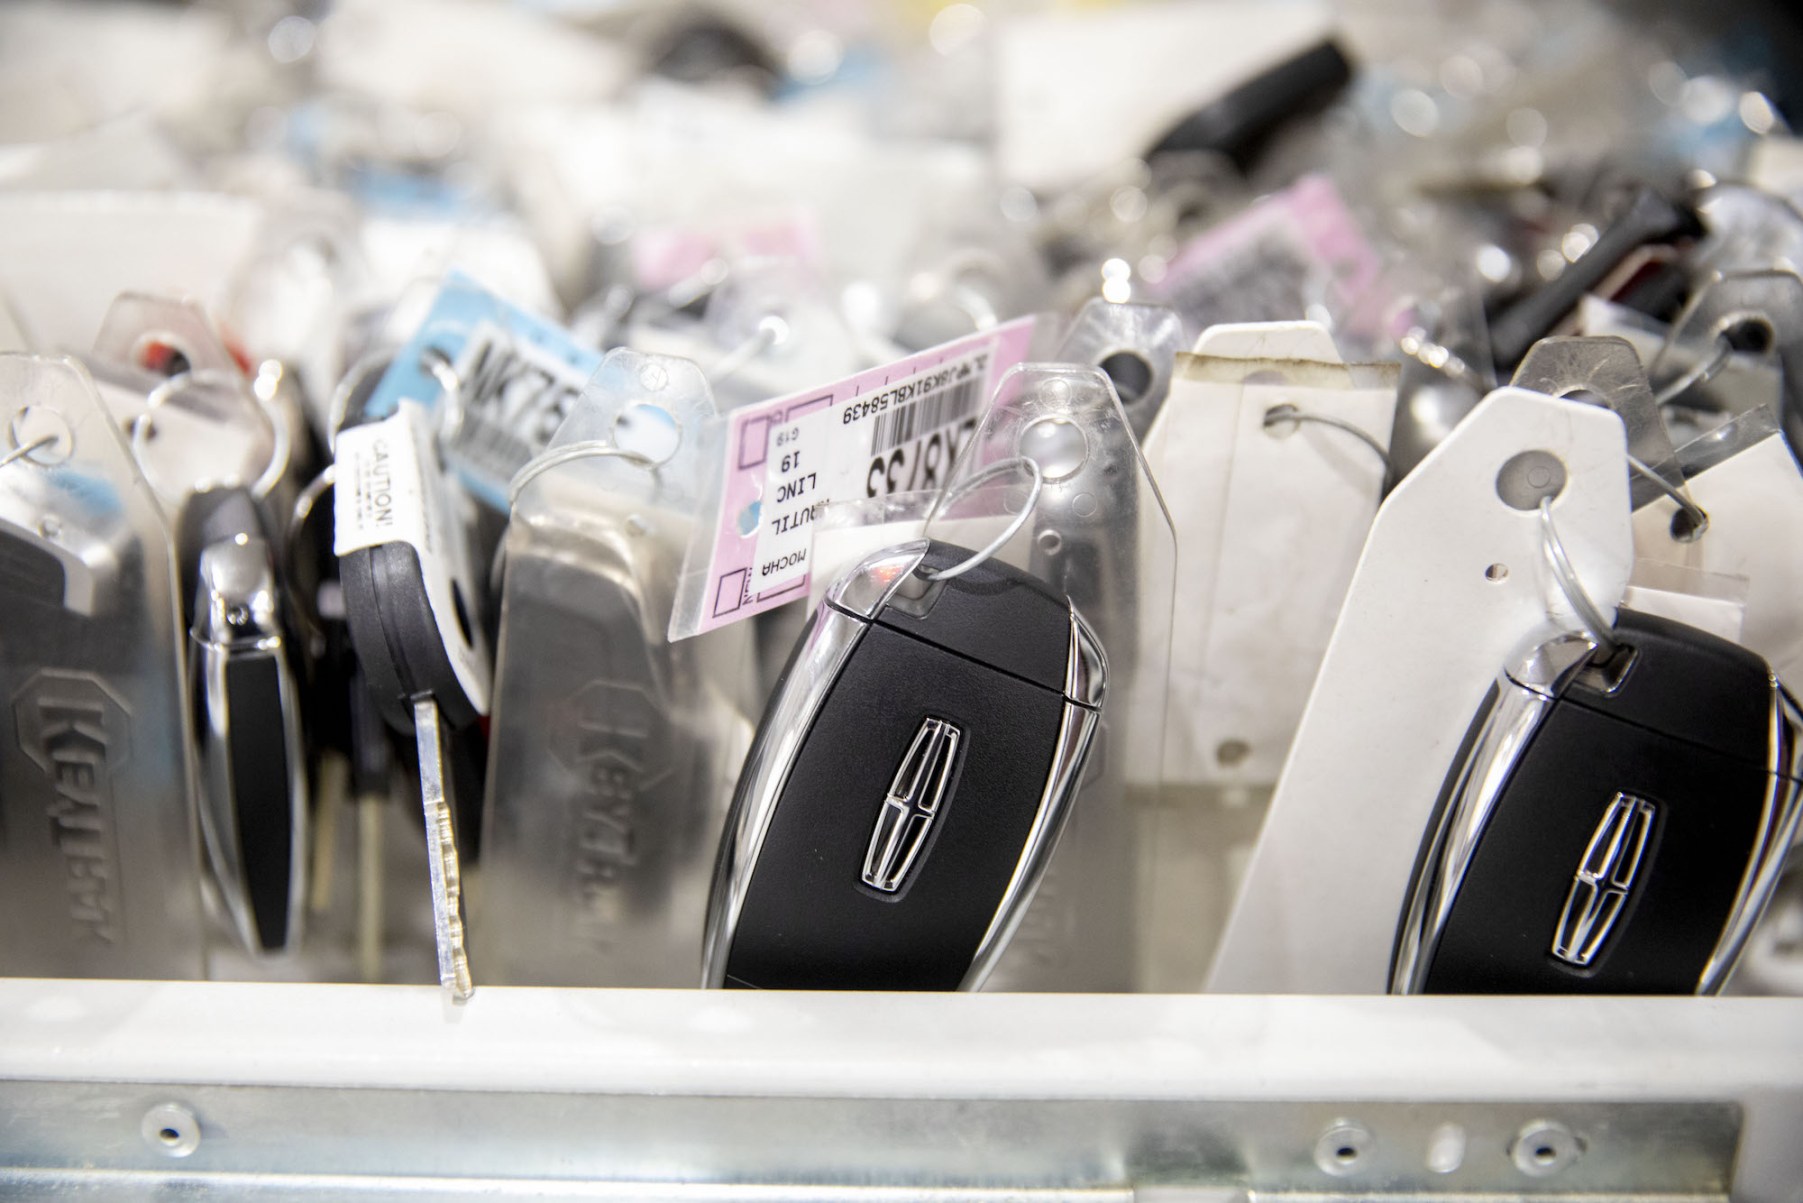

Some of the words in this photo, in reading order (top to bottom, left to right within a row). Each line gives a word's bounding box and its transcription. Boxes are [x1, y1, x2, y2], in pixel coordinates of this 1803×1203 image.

[781, 451, 800, 473] 19
[373, 438, 393, 527] CAUTION!
[777, 472, 817, 503] LINC
[772, 499, 829, 535] AUTIL
[762, 548, 807, 576] MOCHA
